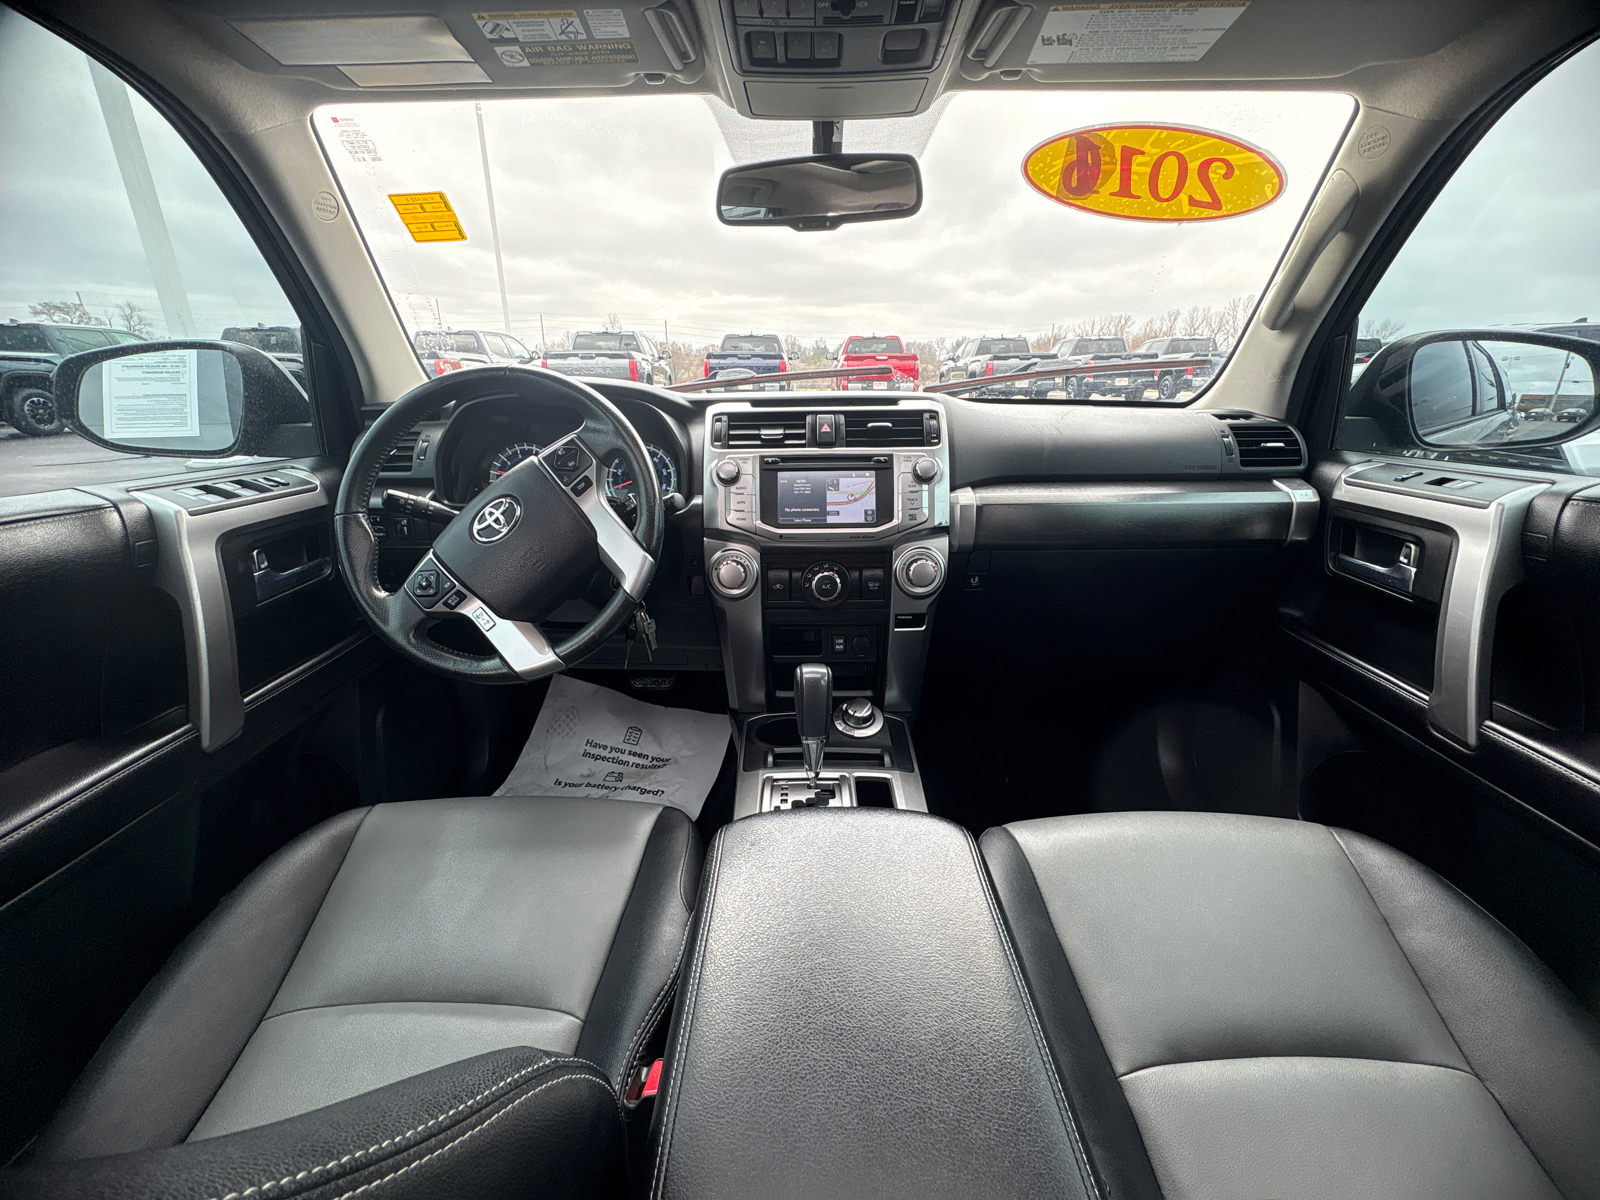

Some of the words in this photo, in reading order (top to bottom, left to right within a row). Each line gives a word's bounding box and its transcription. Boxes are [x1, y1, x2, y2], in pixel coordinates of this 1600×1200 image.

[576, 42, 632, 50] WARNING
[585, 738, 608, 751] Have
[608, 745, 626, 755] you
[627, 750, 649, 760] seen
[582, 749, 630, 767] inspection
[631, 762, 667, 770] results?
[585, 782, 620, 792] battery
[621, 785, 665, 797] charged?
